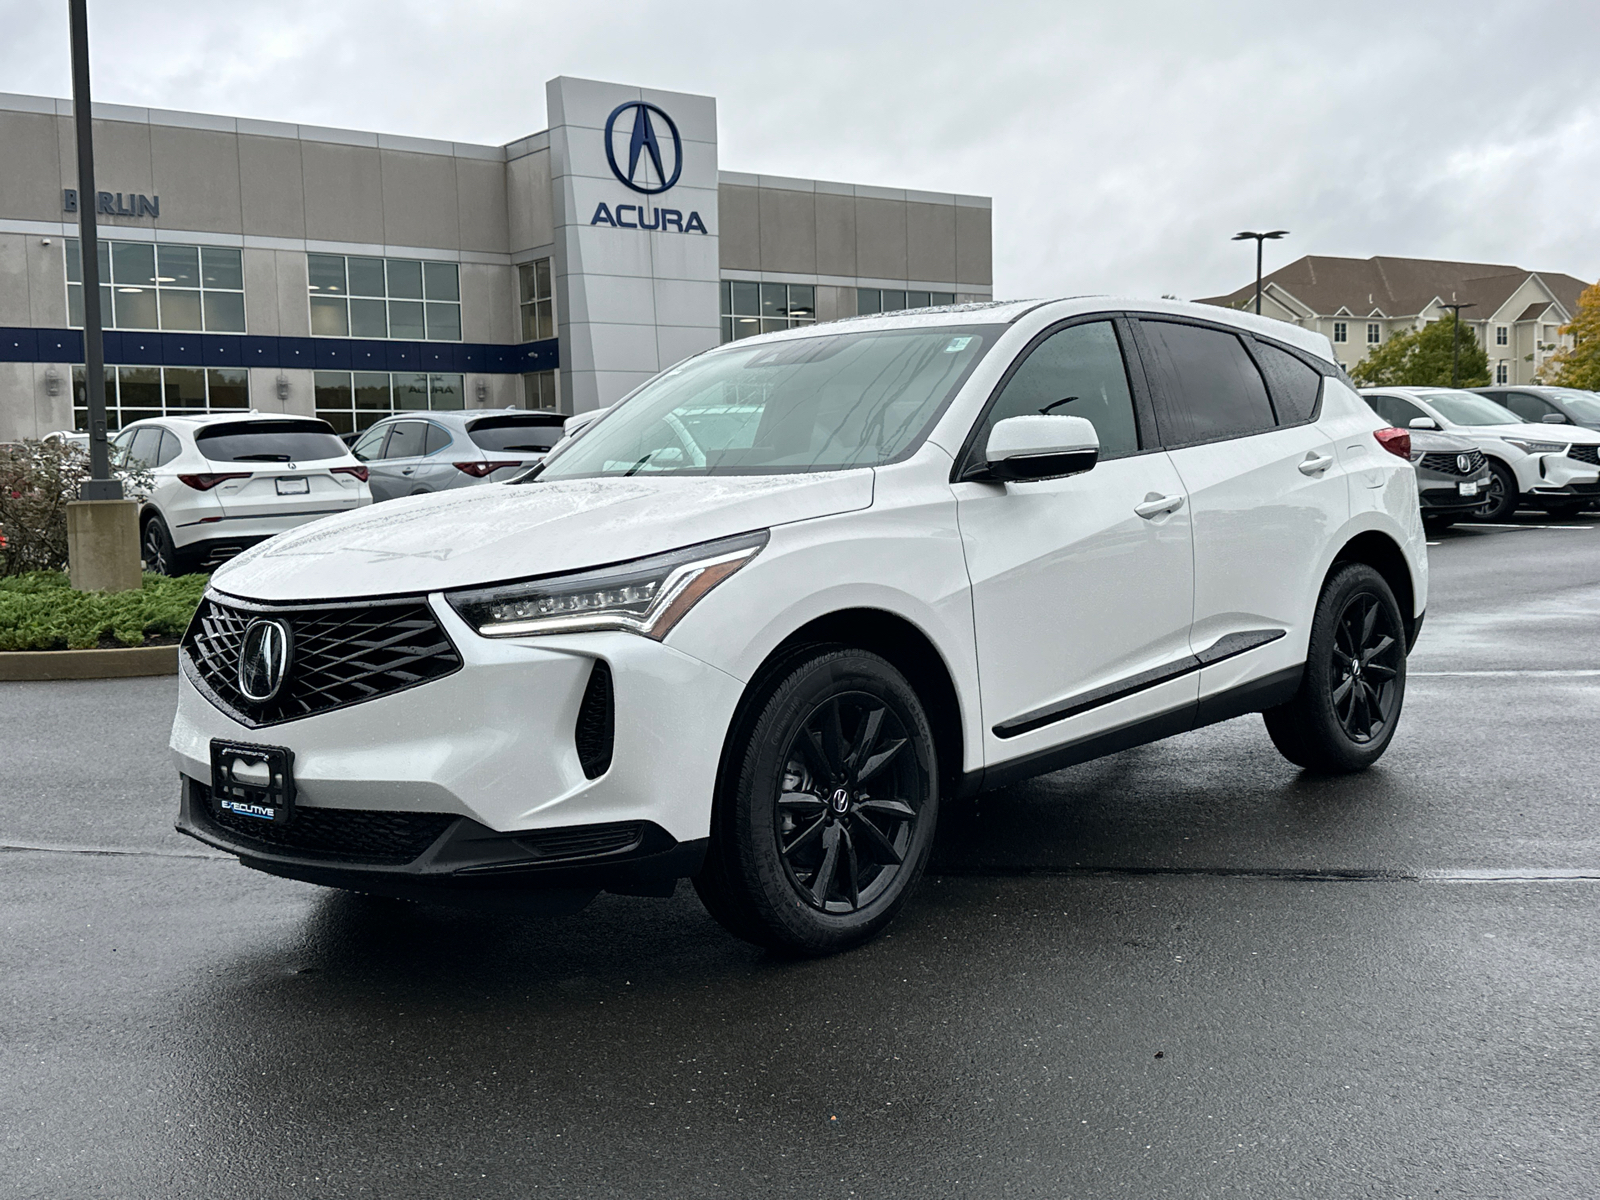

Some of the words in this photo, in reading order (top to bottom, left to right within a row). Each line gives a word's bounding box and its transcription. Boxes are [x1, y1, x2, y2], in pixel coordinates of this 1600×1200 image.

[64, 189, 160, 218] BRLIN
[590, 202, 708, 235] ACURA
[221, 800, 275, 817] EXECUTIVE
